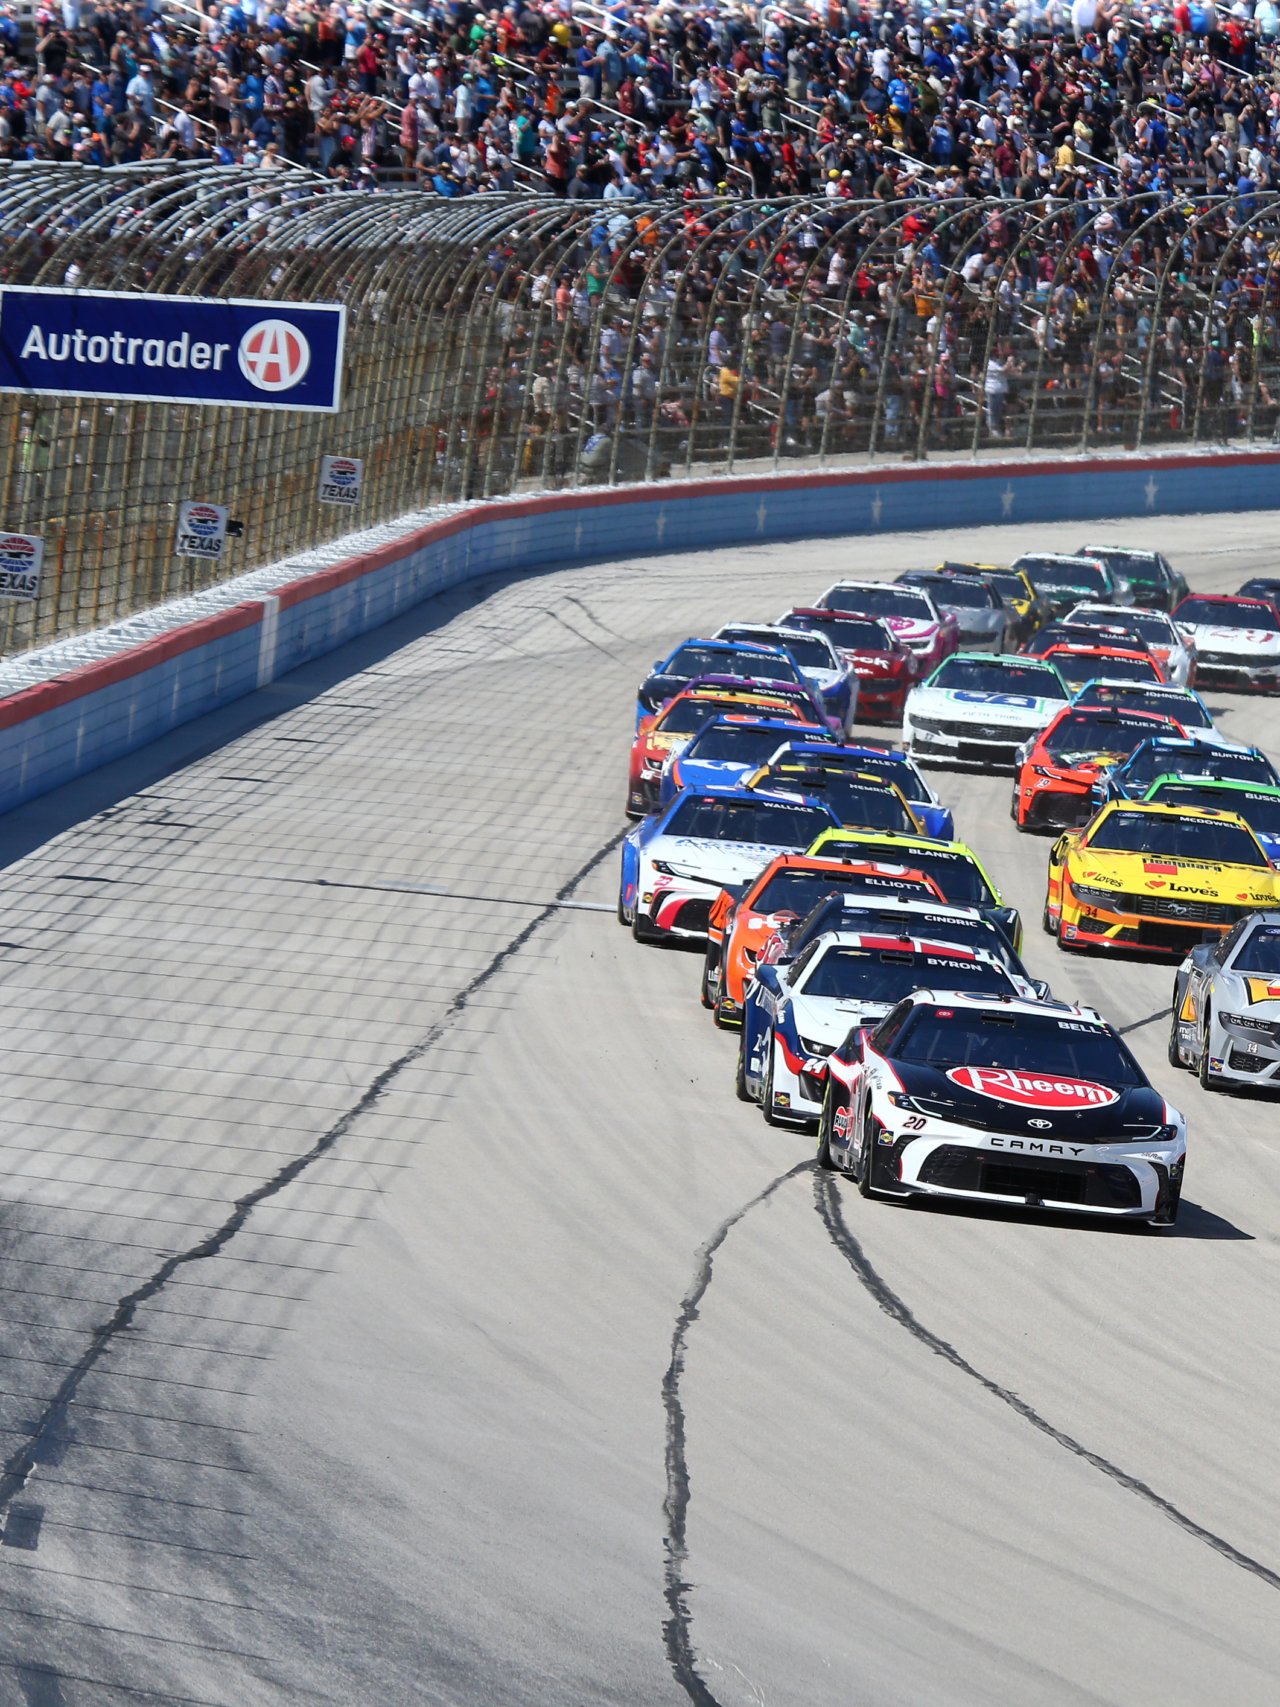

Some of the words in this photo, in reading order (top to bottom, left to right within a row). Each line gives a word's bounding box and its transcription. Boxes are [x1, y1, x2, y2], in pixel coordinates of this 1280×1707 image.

[20, 325, 230, 371] Autotrader
[322, 484, 358, 499] TEXAS
[180, 534, 222, 551] TEXAS
[0, 572, 37, 592] EXAS
[752, 687, 801, 700] BOWMAN
[1143, 691, 1193, 702] JOHNSON
[1120, 719, 1158, 729] TRUEX
[804, 733, 831, 743] HILL
[863, 758, 898, 768] HALEY
[1211, 751, 1254, 762] BURTON
[763, 802, 815, 813] WALLACE
[908, 848, 958, 861] BLANEY
[864, 877, 921, 892] ELLIOTT
[1085, 906, 1098, 918] 34
[924, 914, 978, 928] CINDRIC
[926, 957, 982, 973] BYRON
[1058, 1021, 1101, 1035] BELL
[1247, 1042, 1259, 1054] 14
[802, 1058, 827, 1075] 24
[966, 1067, 1110, 1104] Rheem
[903, 1115, 927, 1131] 20
[990, 1137, 1087, 1156] CAMRY
